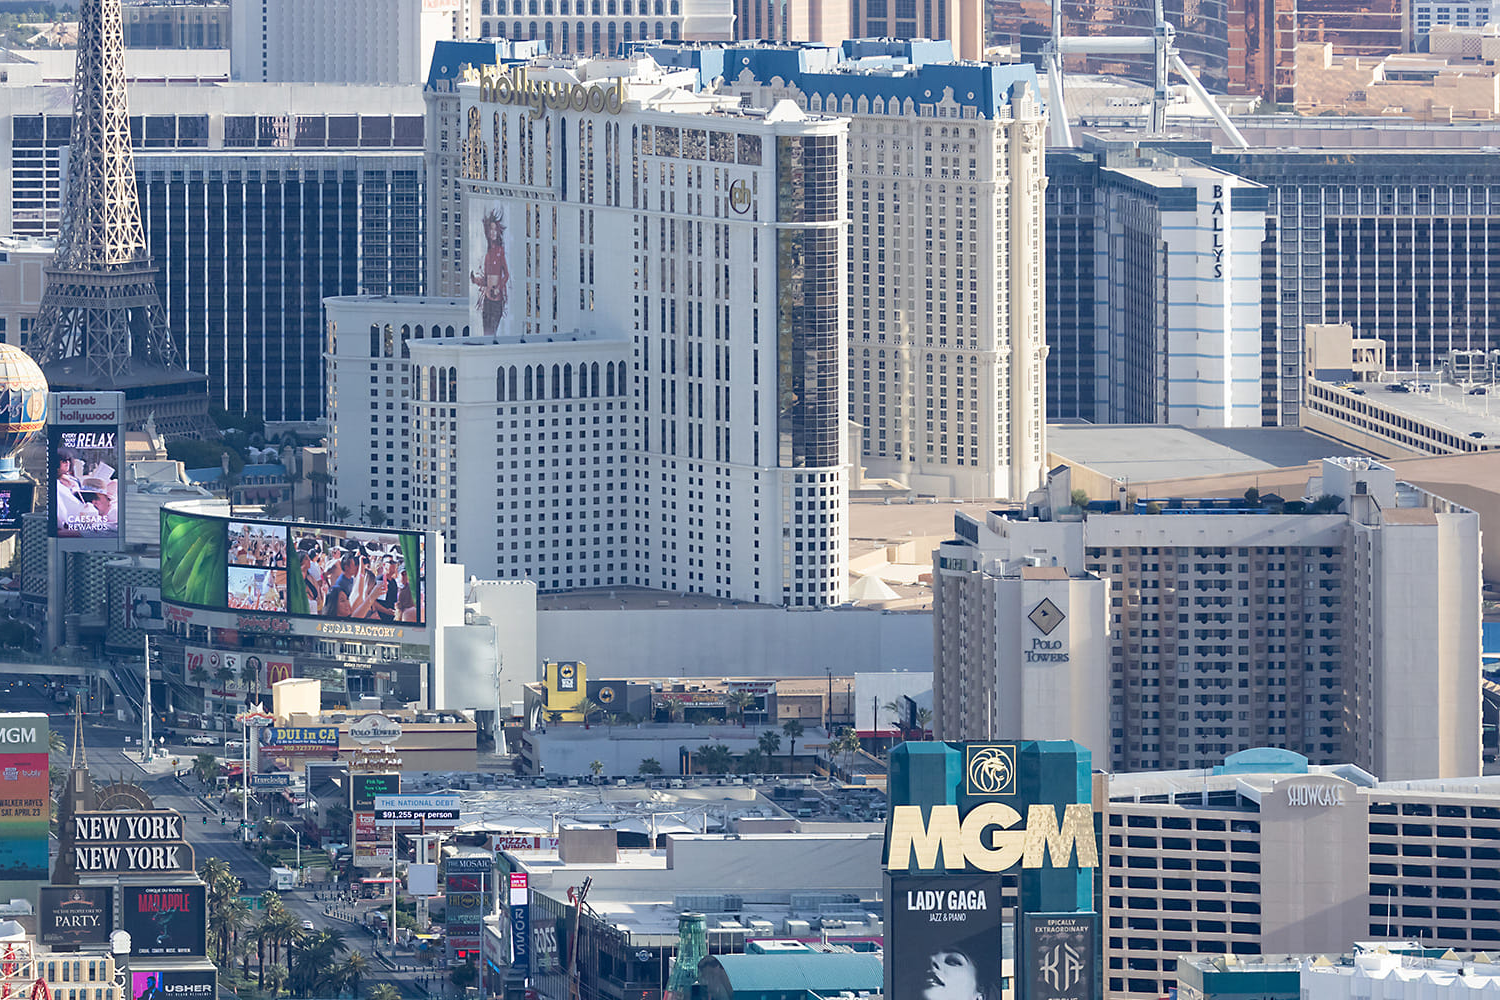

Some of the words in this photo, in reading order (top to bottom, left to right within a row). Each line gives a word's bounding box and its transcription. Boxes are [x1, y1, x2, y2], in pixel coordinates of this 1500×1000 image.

[480, 63, 623, 120] hollywood
[60, 396, 97, 407] planet
[60, 411, 115, 423] hollywood
[76, 433, 115, 448] RELAX
[68, 515, 108, 523] CAESARS
[323, 623, 353, 635] SUGAR
[355, 625, 396, 638] FACTORY
[1032, 638, 1062, 650] POLO
[1024, 650, 1070, 663] TOWERS
[277, 729, 301, 740] DUI
[303, 729, 316, 739] in
[319, 729, 336, 740] CA
[351, 728, 371, 736] POLO
[372, 728, 401, 736] TOWERS
[253, 775, 288, 785] Travelodge
[1287, 784, 1345, 808] SHOWCASE
[0, 799, 23, 807] WALKER
[24, 799, 44, 807] HAYES
[15, 809, 31, 817] APRIL
[427, 812, 453, 820] person
[75, 817, 122, 840] NEW
[125, 816, 180, 840] YORK
[888, 802, 1099, 873] MGM
[75, 847, 122, 870] NEW
[125, 846, 180, 870] YORK
[460, 860, 490, 868] MOSAIC
[907, 890, 945, 911] LADY
[948, 890, 987, 910] GAGA
[55, 915, 100, 927] PARTY.
[929, 914, 942, 922] JAZZ
[515, 909, 525, 955] ROSS
[165, 984, 212, 992] USHER
